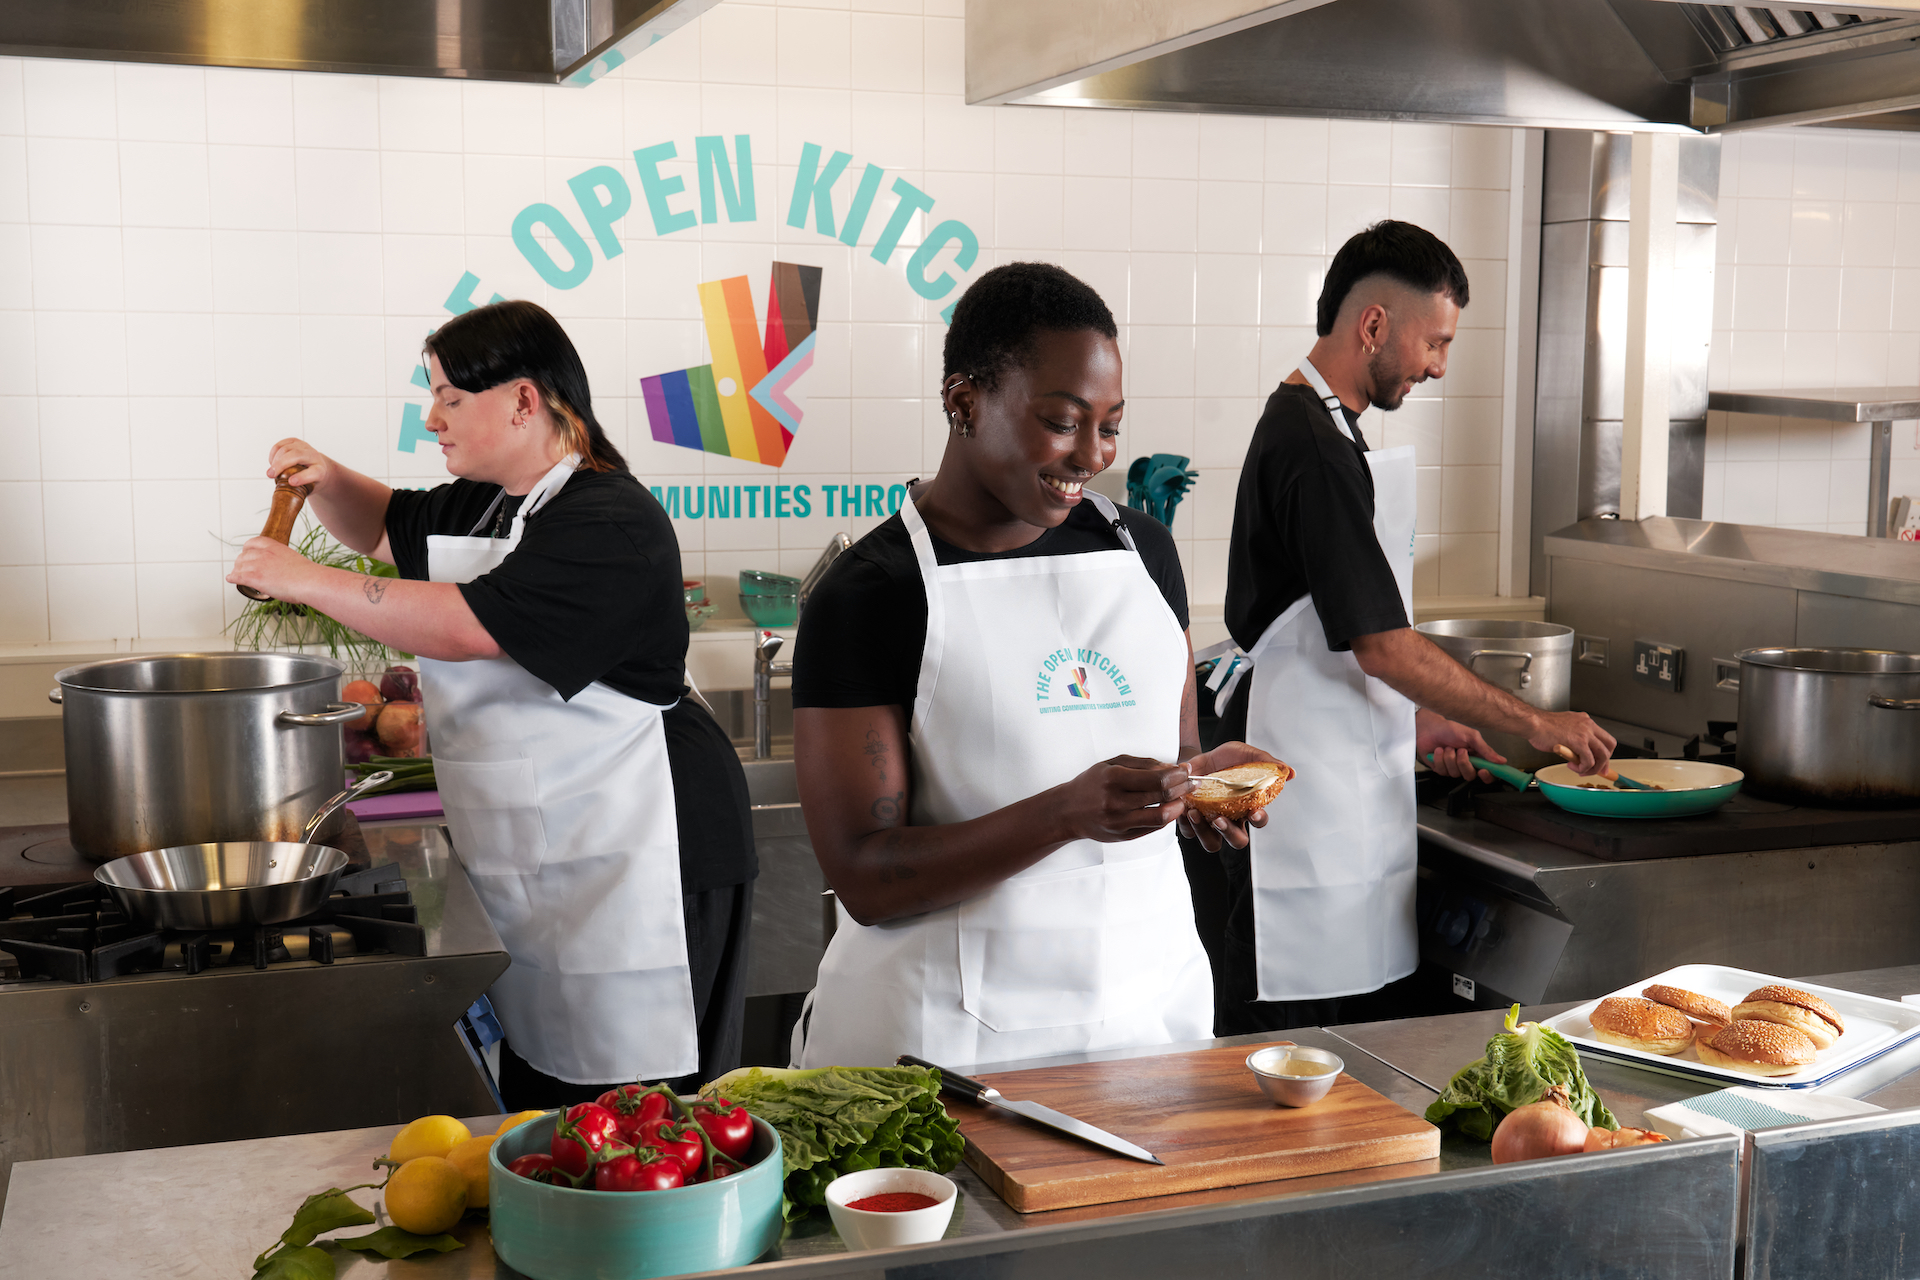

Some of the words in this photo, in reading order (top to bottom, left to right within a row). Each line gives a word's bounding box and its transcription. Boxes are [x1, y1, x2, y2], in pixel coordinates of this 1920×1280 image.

[511, 134, 757, 290] OPEN
[786, 141, 979, 327] KITC
[650, 485, 811, 519] MUNITIES
[821, 484, 907, 517] THRO
[1043, 648, 1073, 672] OPEN
[1077, 648, 1132, 696] KITCHEN
[1036, 671, 1051, 701] THE
[1039, 706, 1061, 714] UNITING
[1062, 704, 1097, 712] COMMUNITIES
[1097, 702, 1121, 710] THROUGH
[1121, 700, 1136, 708] FOOD
